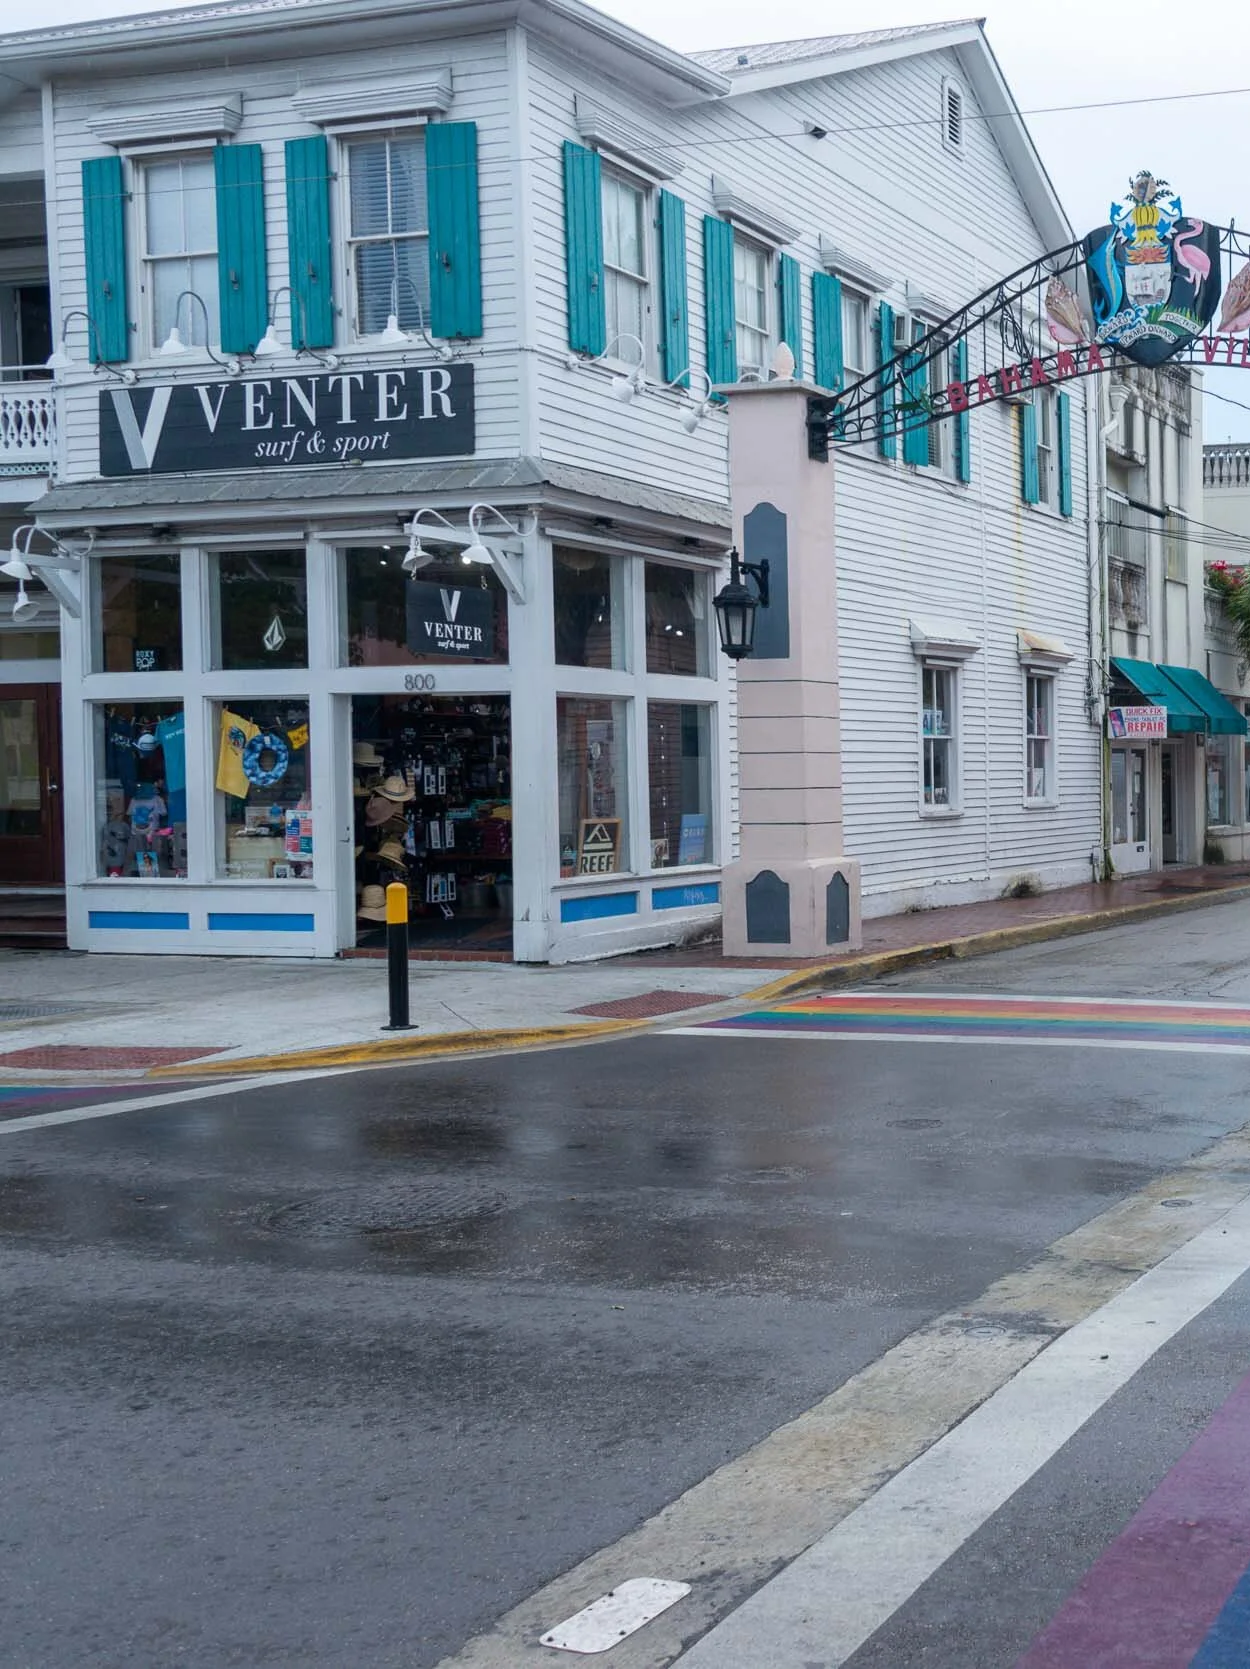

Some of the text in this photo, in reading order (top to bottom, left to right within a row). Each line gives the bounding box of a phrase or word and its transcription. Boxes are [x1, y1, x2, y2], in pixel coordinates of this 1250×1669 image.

[947, 343, 1104, 413] BAHAMA
[194, 368, 456, 433] VENTER
[254, 430, 391, 462] surf & sport
[424, 621, 483, 642] VENTER
[404, 673, 436, 691] 800
[1127, 722, 1164, 732] REPAIR
[580, 854, 615, 874] REEF
